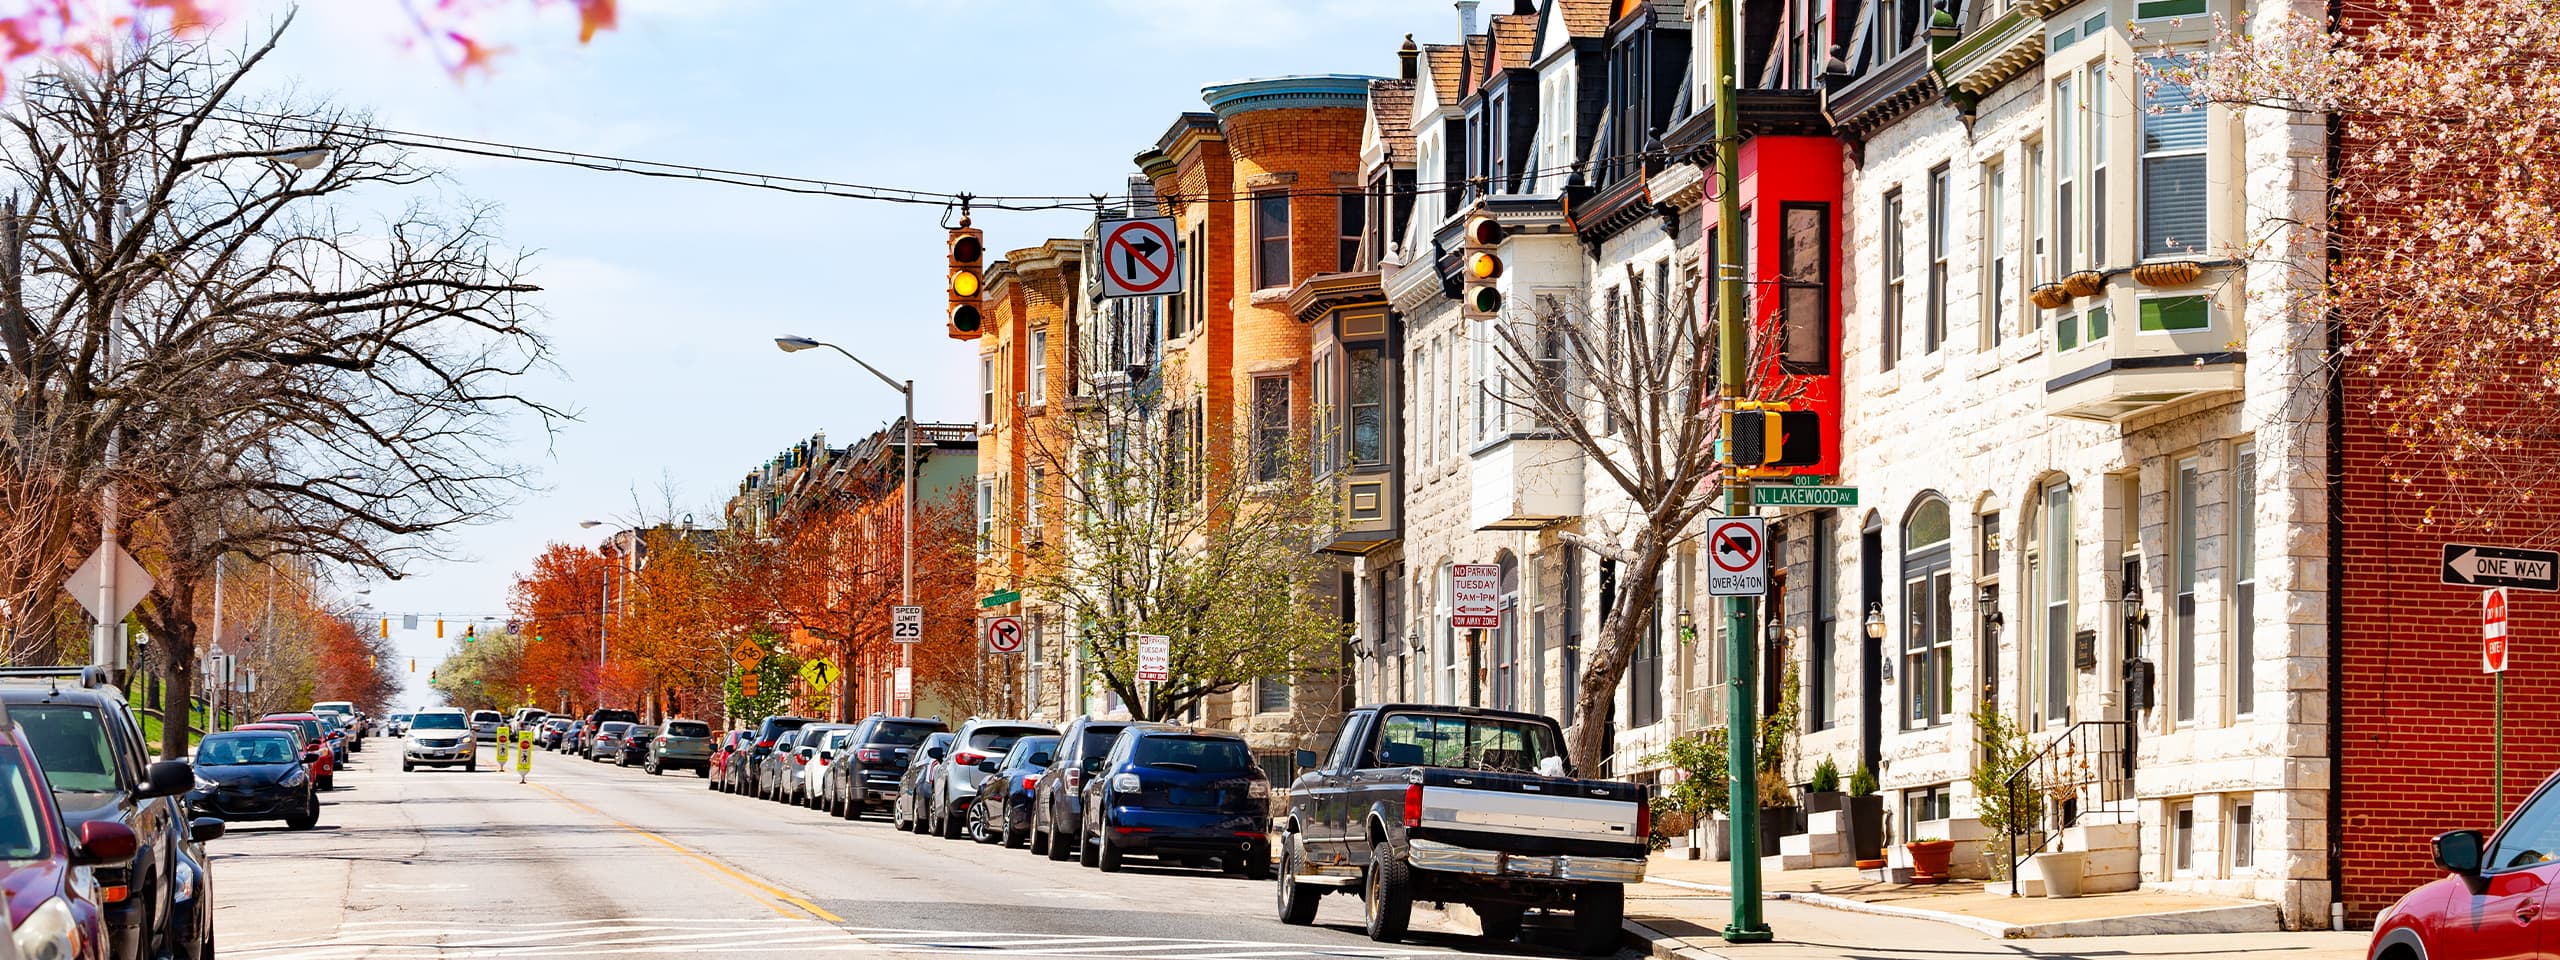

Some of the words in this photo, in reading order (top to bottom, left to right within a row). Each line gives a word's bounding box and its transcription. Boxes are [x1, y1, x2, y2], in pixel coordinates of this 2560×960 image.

[1757, 490, 1769, 503] N.
[1773, 489, 1839, 504] LAKEWOOD
[1454, 566, 1466, 576] NO
[1467, 567, 1497, 577] PARKING
[2476, 559, 2508, 575] ONE
[2514, 561, 2546, 577] WAY
[1455, 580, 1496, 589] TUESDAY
[1712, 576, 1731, 589] OVER
[1732, 574, 1745, 591] 3/4
[1745, 576, 1762, 588] TON
[1456, 592, 1495, 601] 9AM-1PM
[2487, 607, 2494, 620] DO
[1454, 616, 1466, 625] TOW
[1466, 616, 1482, 625] AWAY
[1482, 616, 1497, 625] ZONE
[895, 622, 919, 637] 25
